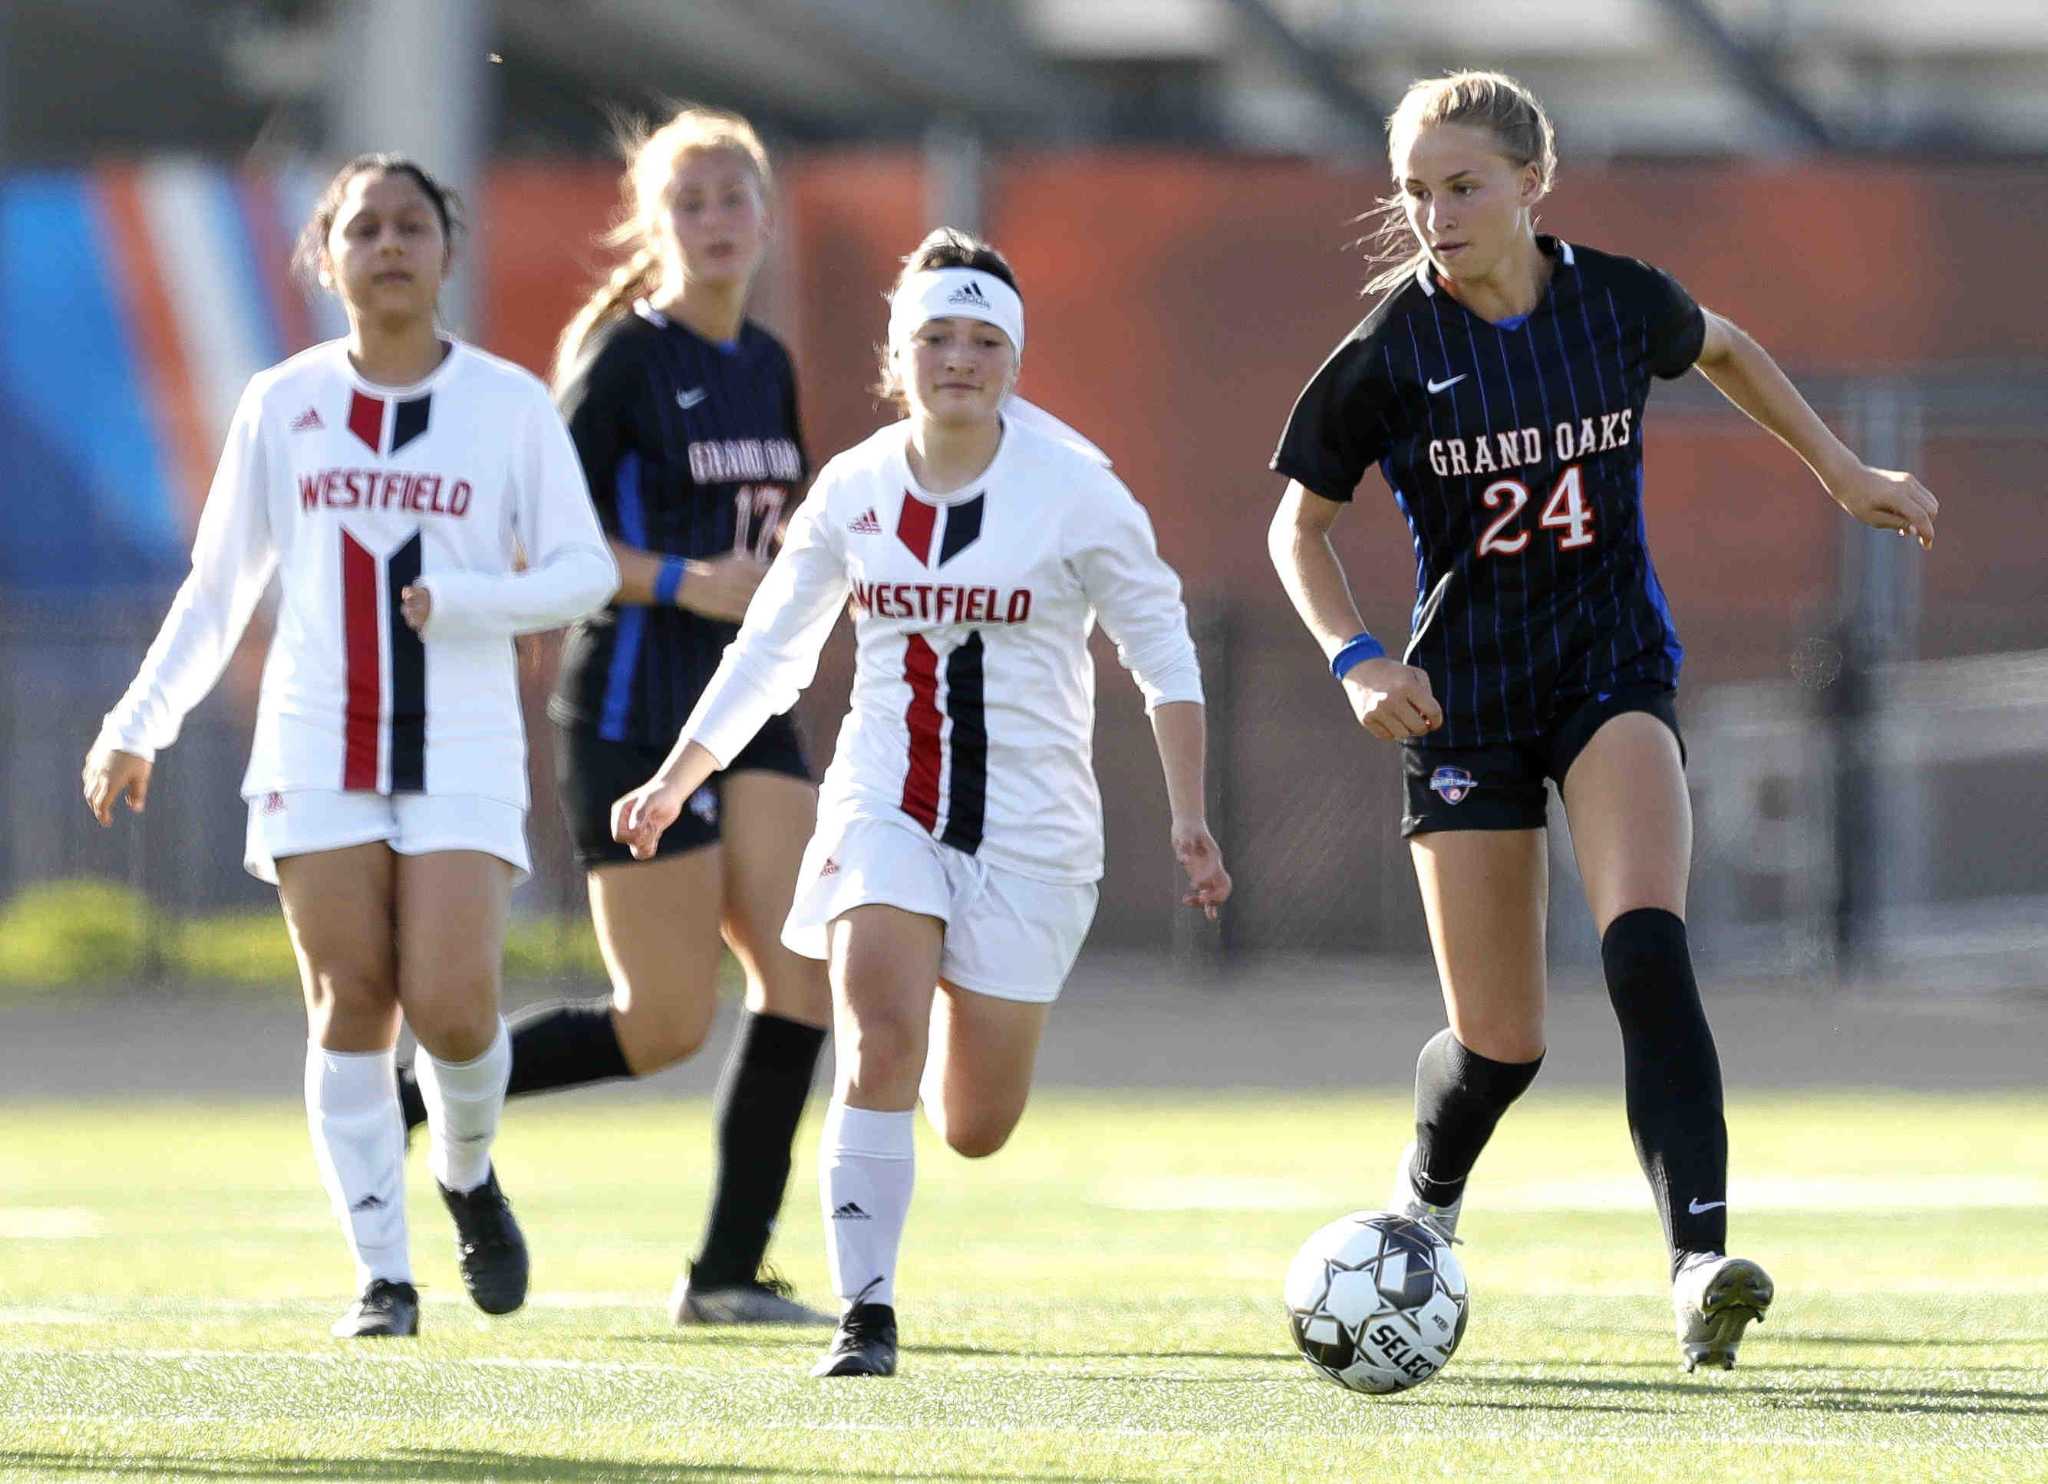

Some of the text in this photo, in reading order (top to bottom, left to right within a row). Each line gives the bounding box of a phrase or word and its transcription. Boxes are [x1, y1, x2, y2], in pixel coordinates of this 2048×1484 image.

[1428, 407, 1633, 477] GRAND OAKS
[298, 469, 474, 519] WESTFIELD
[1477, 463, 1597, 560] 24
[851, 578, 1032, 626] WESTFIELD
